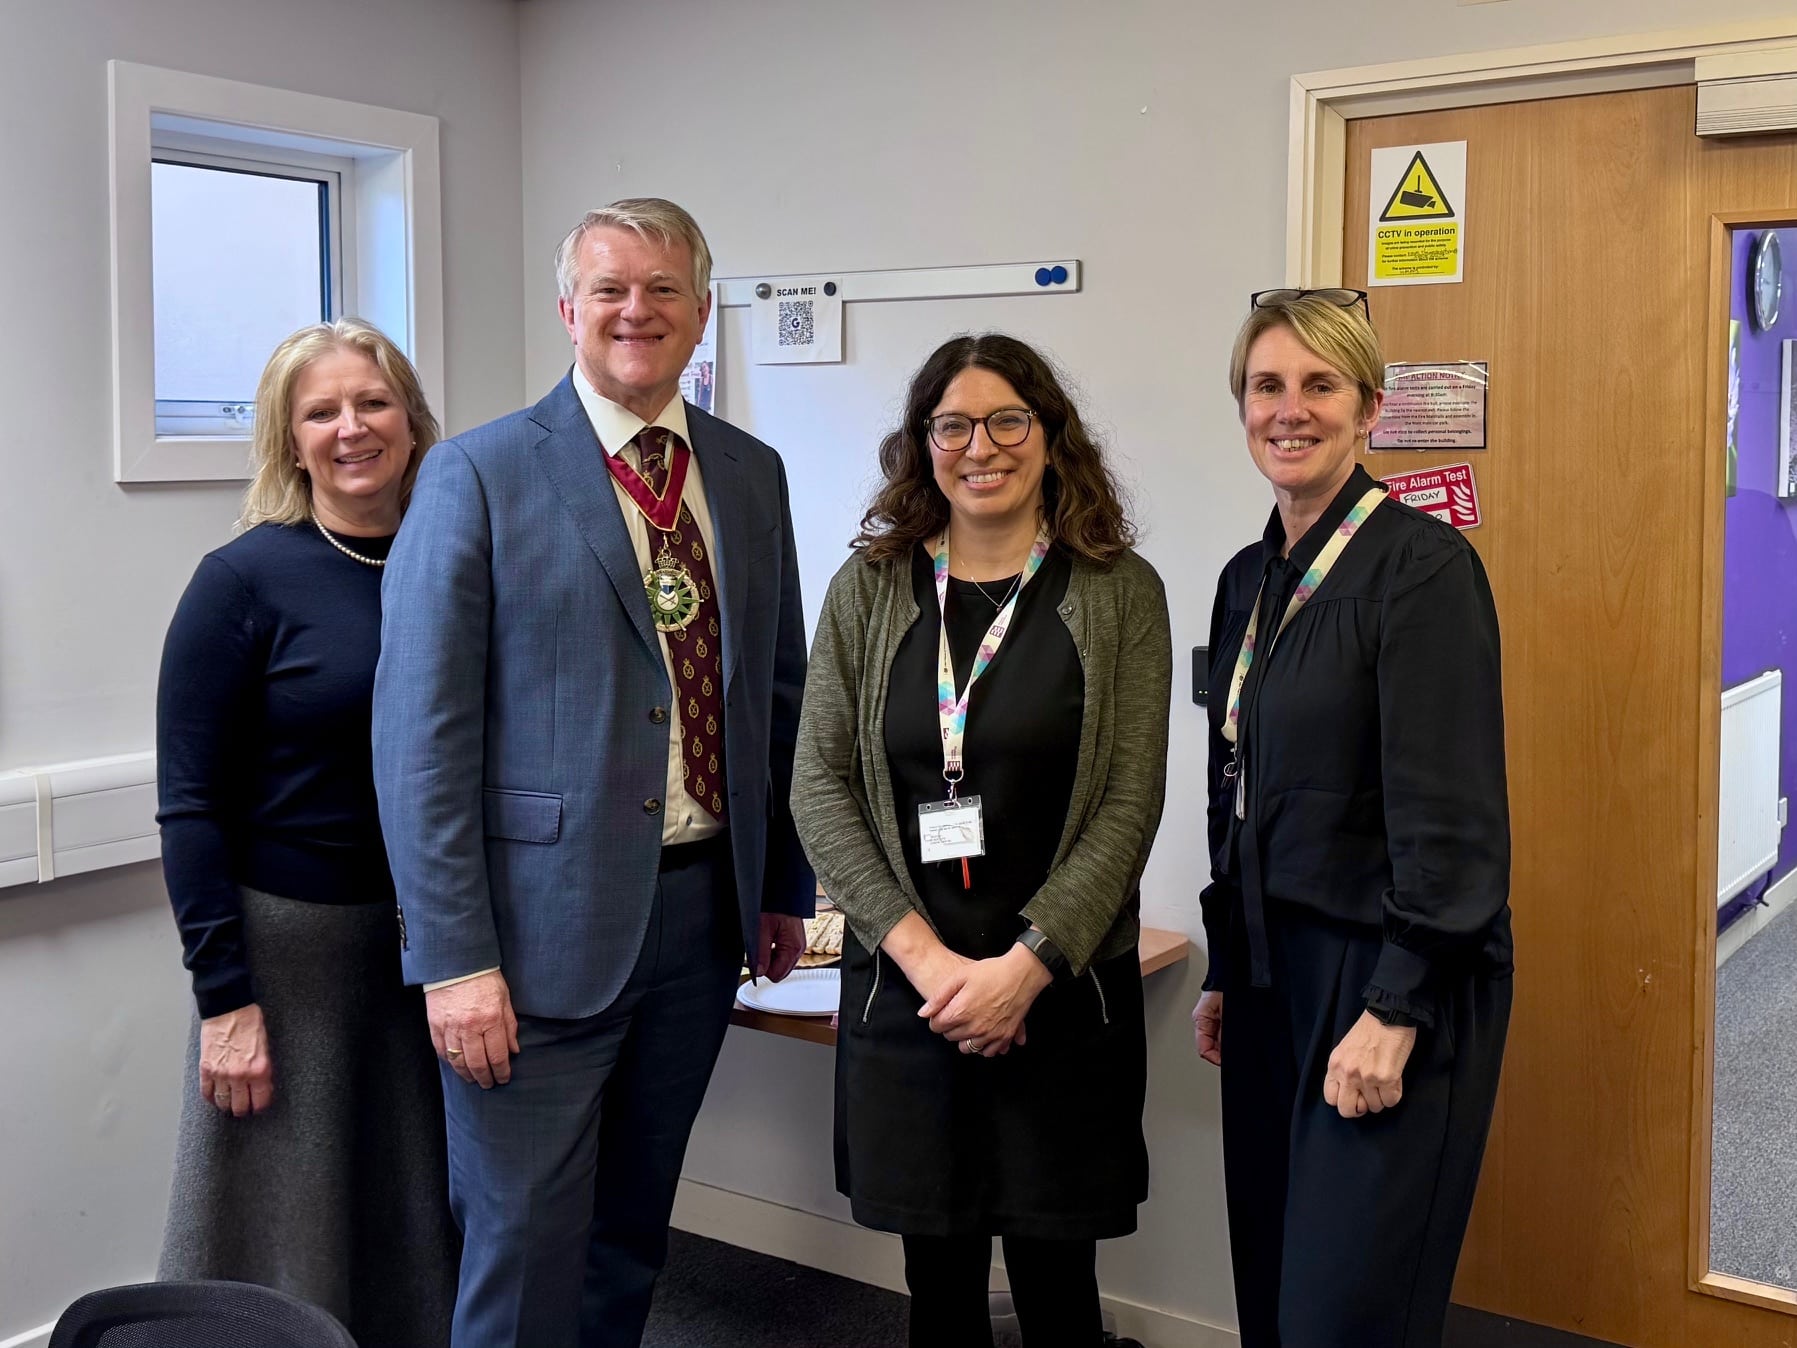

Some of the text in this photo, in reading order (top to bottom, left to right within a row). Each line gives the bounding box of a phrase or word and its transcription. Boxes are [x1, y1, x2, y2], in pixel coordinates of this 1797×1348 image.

[1378, 228, 1455, 239] CCTV in operation
[777, 287, 817, 297] SCAN ME!
[791, 317, 800, 329] G
[1411, 371, 1438, 381] ACTION
[1387, 469, 1467, 492] Fire Alarm Test
[1403, 490, 1440, 504] FRIDAY
